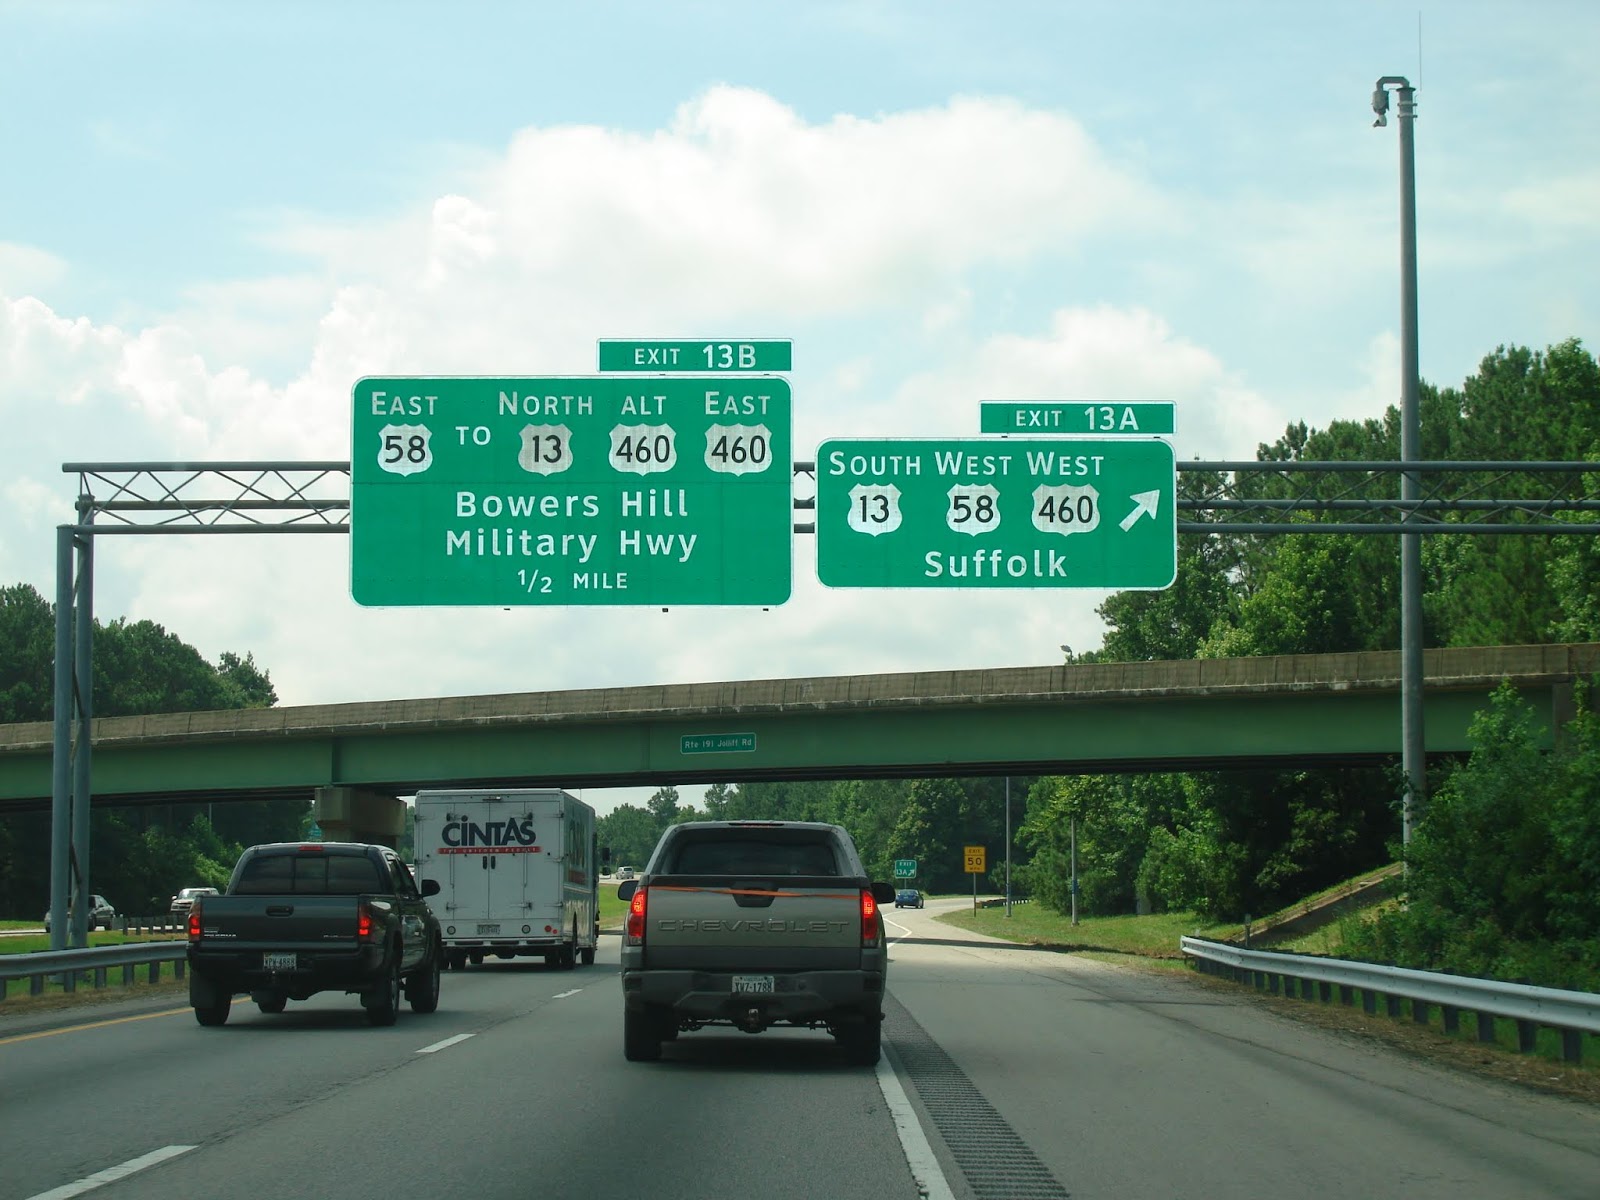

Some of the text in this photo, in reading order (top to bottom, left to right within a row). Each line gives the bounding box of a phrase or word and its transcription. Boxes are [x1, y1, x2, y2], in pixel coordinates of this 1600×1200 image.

[634, 344, 757, 369] EXIT 13B
[372, 391, 771, 416] EAST NORTH ALT EAST
[1015, 406, 1139, 431] EXIT 13A
[384, 426, 767, 463] 58 TO 13 460 460
[829, 450, 1104, 476] SOUTH WEST WEST
[456, 489, 688, 518] Bowers Hill
[859, 495, 1094, 523] 13 58 460
[446, 529, 698, 563] Military Hwy
[924, 548, 1068, 577] Suffolk
[518, 569, 628, 594] 1/2 MILE
[703, 740, 713, 748] 191
[742, 738, 752, 746] Rd
[968, 857, 982, 865] 50
[658, 920, 849, 933] CHEVROLET
